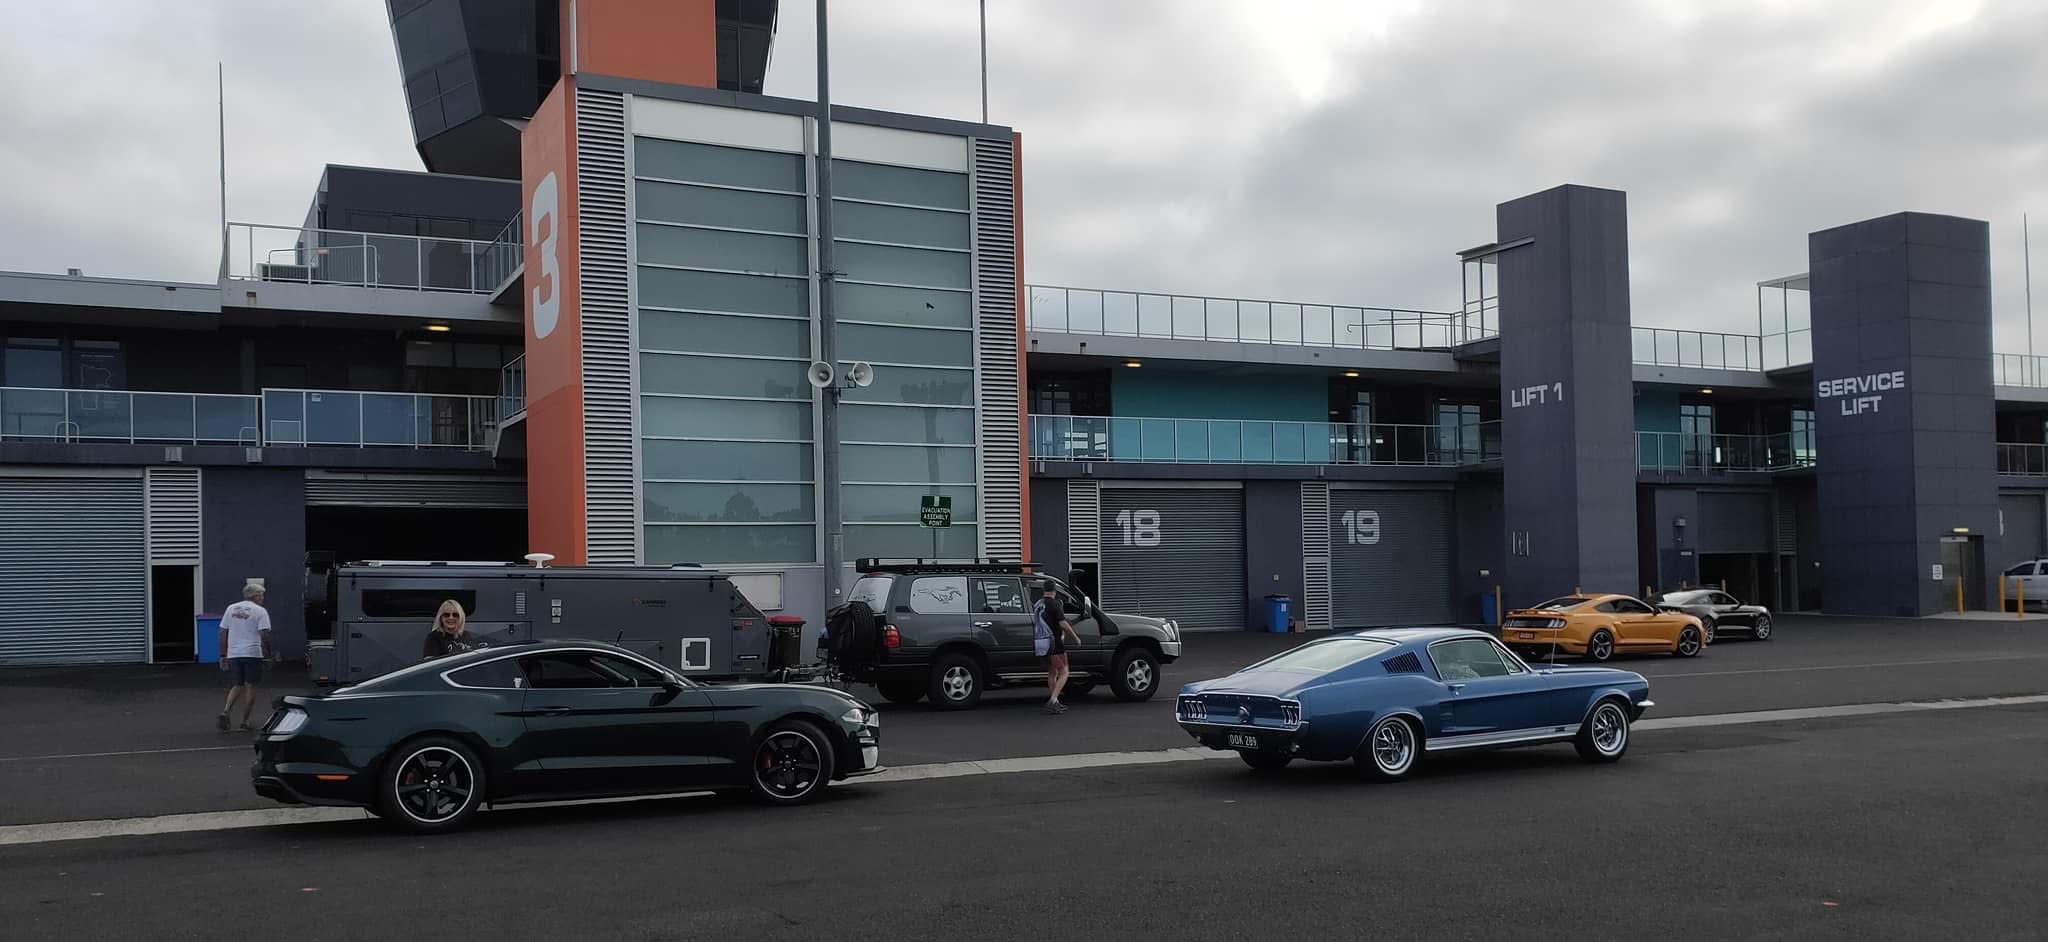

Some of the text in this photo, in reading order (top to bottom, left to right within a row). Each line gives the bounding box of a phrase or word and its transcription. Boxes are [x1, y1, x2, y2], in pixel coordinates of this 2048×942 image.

[531, 171, 560, 340] 3
[1511, 382, 1562, 408] LIFT 1
[1818, 371, 1905, 398] SERVICE
[1841, 395, 1882, 416] LIFT
[921, 506, 951, 514] EVACUATION
[923, 513, 949, 521] ASSEMBLY
[1115, 509, 1161, 546] 18
[1341, 510, 1380, 545] 19
